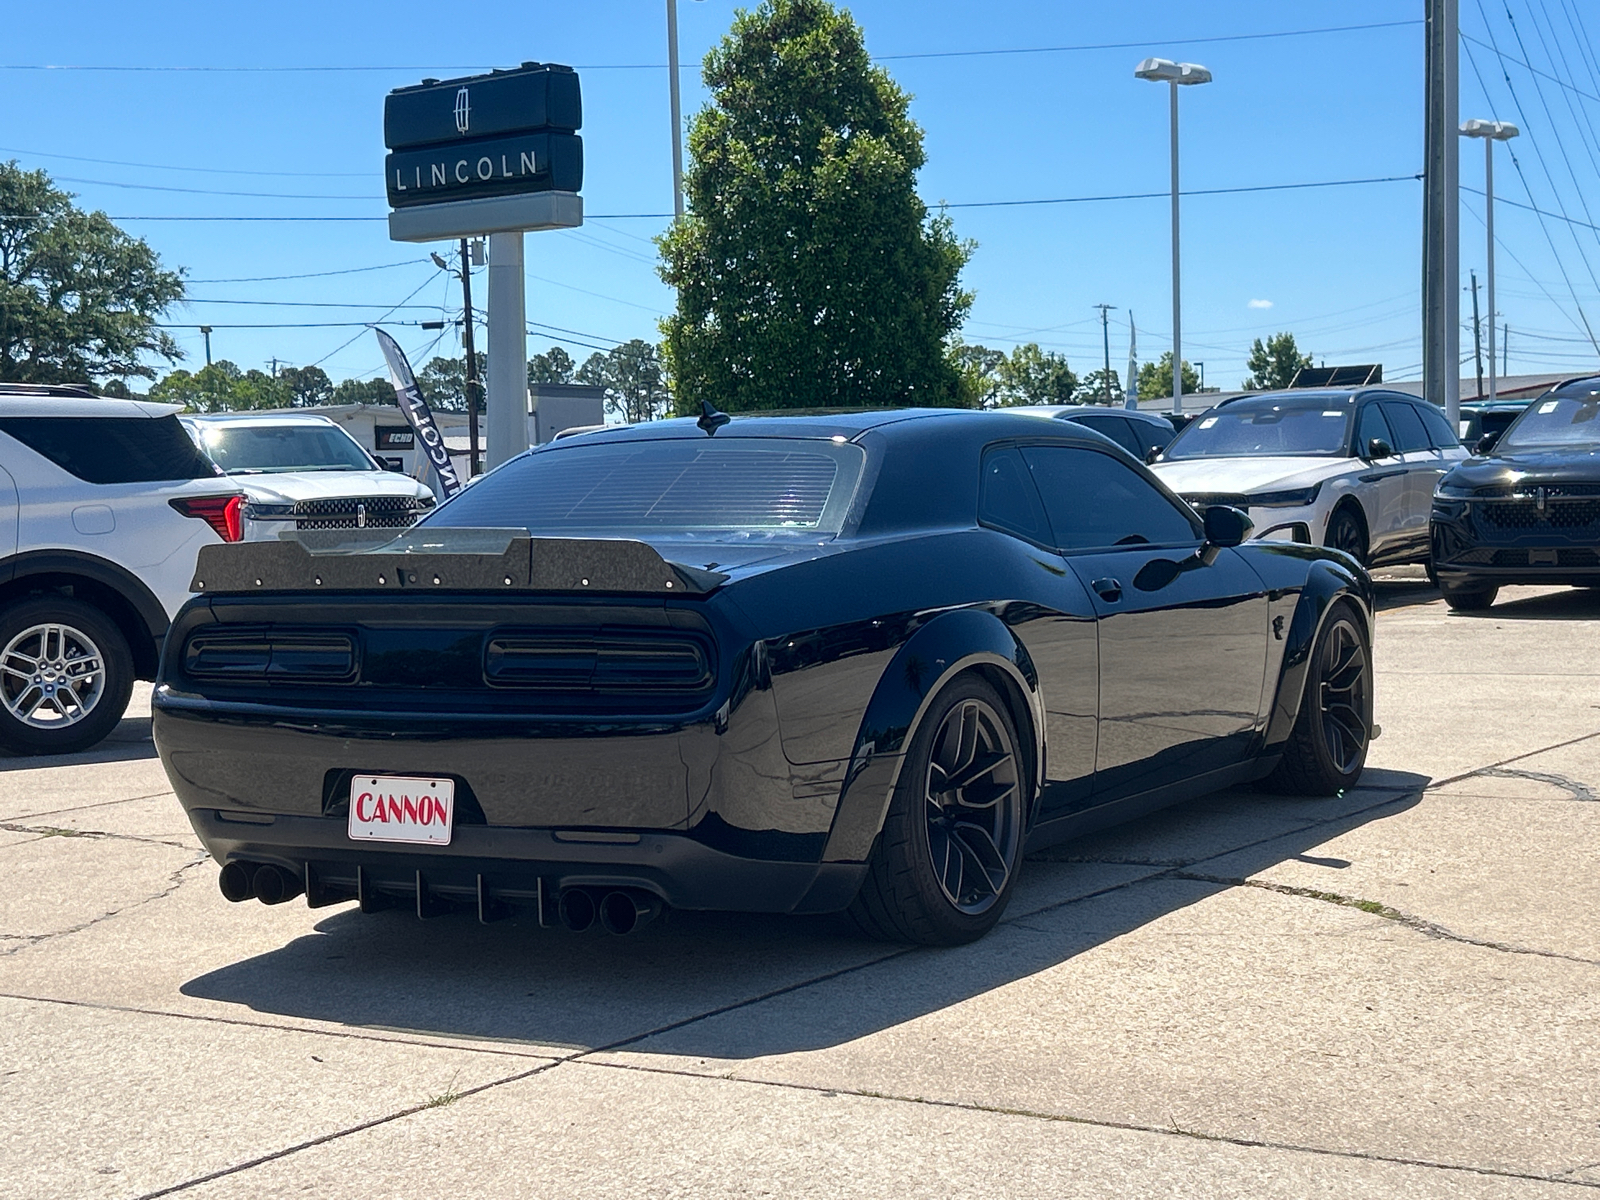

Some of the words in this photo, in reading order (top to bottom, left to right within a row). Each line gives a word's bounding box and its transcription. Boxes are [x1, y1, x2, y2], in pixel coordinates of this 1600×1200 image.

[396, 150, 537, 191] LINCOLN
[388, 433, 413, 443] ECHO
[356, 792, 448, 827] CANNON
